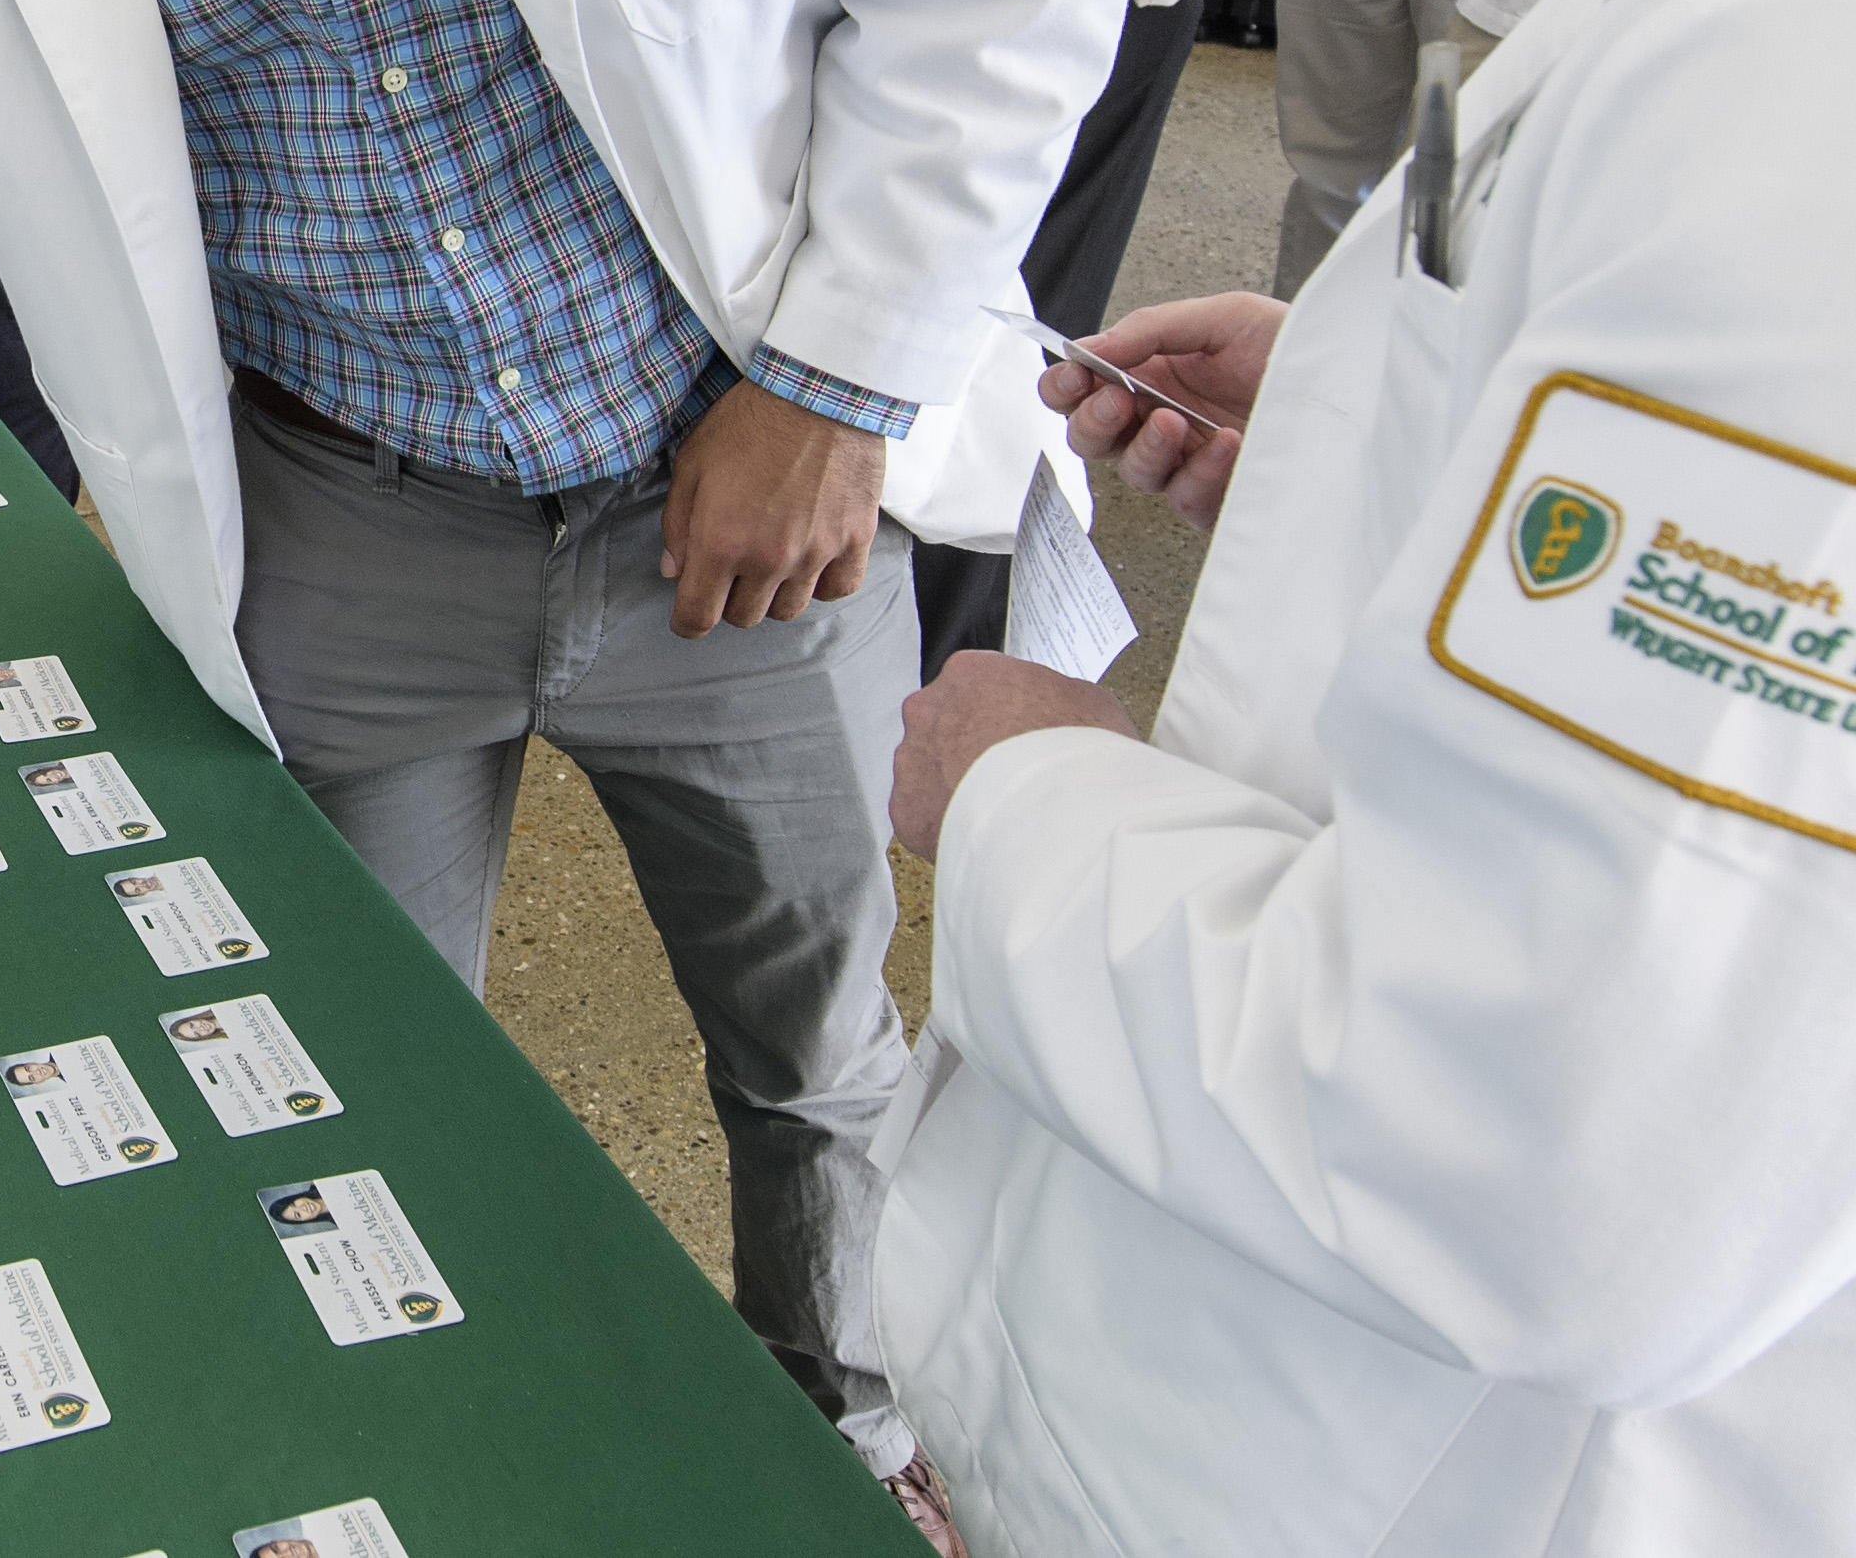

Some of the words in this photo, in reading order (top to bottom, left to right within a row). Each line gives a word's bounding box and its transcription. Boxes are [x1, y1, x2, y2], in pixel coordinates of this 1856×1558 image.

[1625, 552, 1787, 643] School
[1792, 626, 1855, 663] of
[1609, 605, 1736, 684] WRIGHT
[1735, 664, 1838, 723] STATE
[92, 819, 116, 842] JESSICA
[188, 934, 214, 963] MICHAEL
[75, 1043, 108, 1089] Medicine
[90, 1041, 119, 1080] UNIVERSITY
[231, 1051, 269, 1095] FROIMSON
[66, 1095, 88, 1117] FRITZ
[96, 1089, 115, 1099] of
[113, 1080, 131, 1100] STATE
[260, 1097, 281, 1114] JILL
[43, 1098, 72, 1136] Student
[102, 1099, 134, 1133] School
[124, 1100, 147, 1127] WRIGHT
[61, 1136, 93, 1175] Medical
[79, 1119, 113, 1162] GREGORY
[341, 1177, 381, 1232] Medicine
[358, 1176, 393, 1223] UNIVERSITY
[368, 1233, 390, 1245] of
[386, 1224, 408, 1247] STATE
[312, 1241, 346, 1286] Student
[337, 1238, 367, 1273] CHOW
[376, 1245, 413, 1287] School
[401, 1248, 428, 1281] WRIGHT
[334, 1287, 372, 1335] Medical
[358, 1276, 394, 1321] KARISSA
[9, 1391, 32, 1419] ERIN
